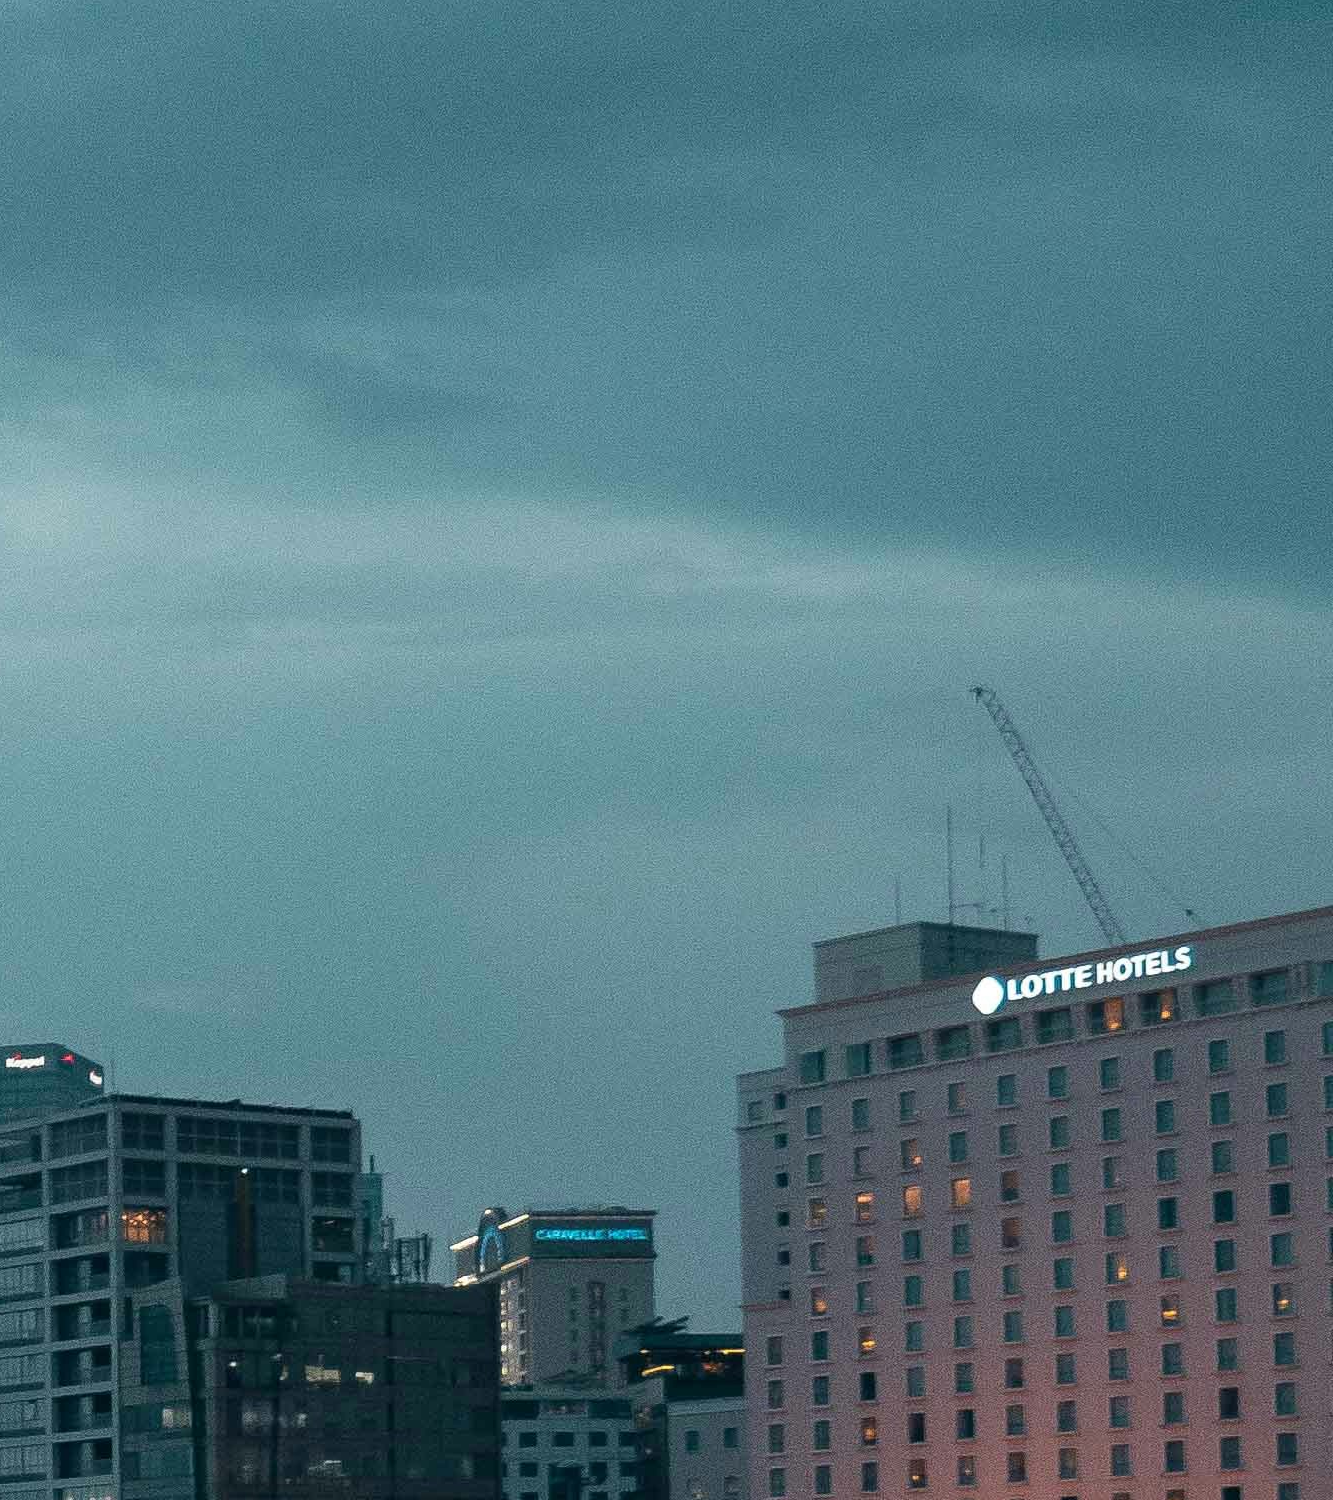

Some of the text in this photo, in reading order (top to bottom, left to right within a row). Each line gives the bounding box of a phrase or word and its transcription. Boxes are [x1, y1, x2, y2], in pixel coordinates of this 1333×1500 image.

[1007, 946, 1191, 1000] LOTTE HOTELS
[535, 1228, 647, 1241] CARAVELLE HOTEL
